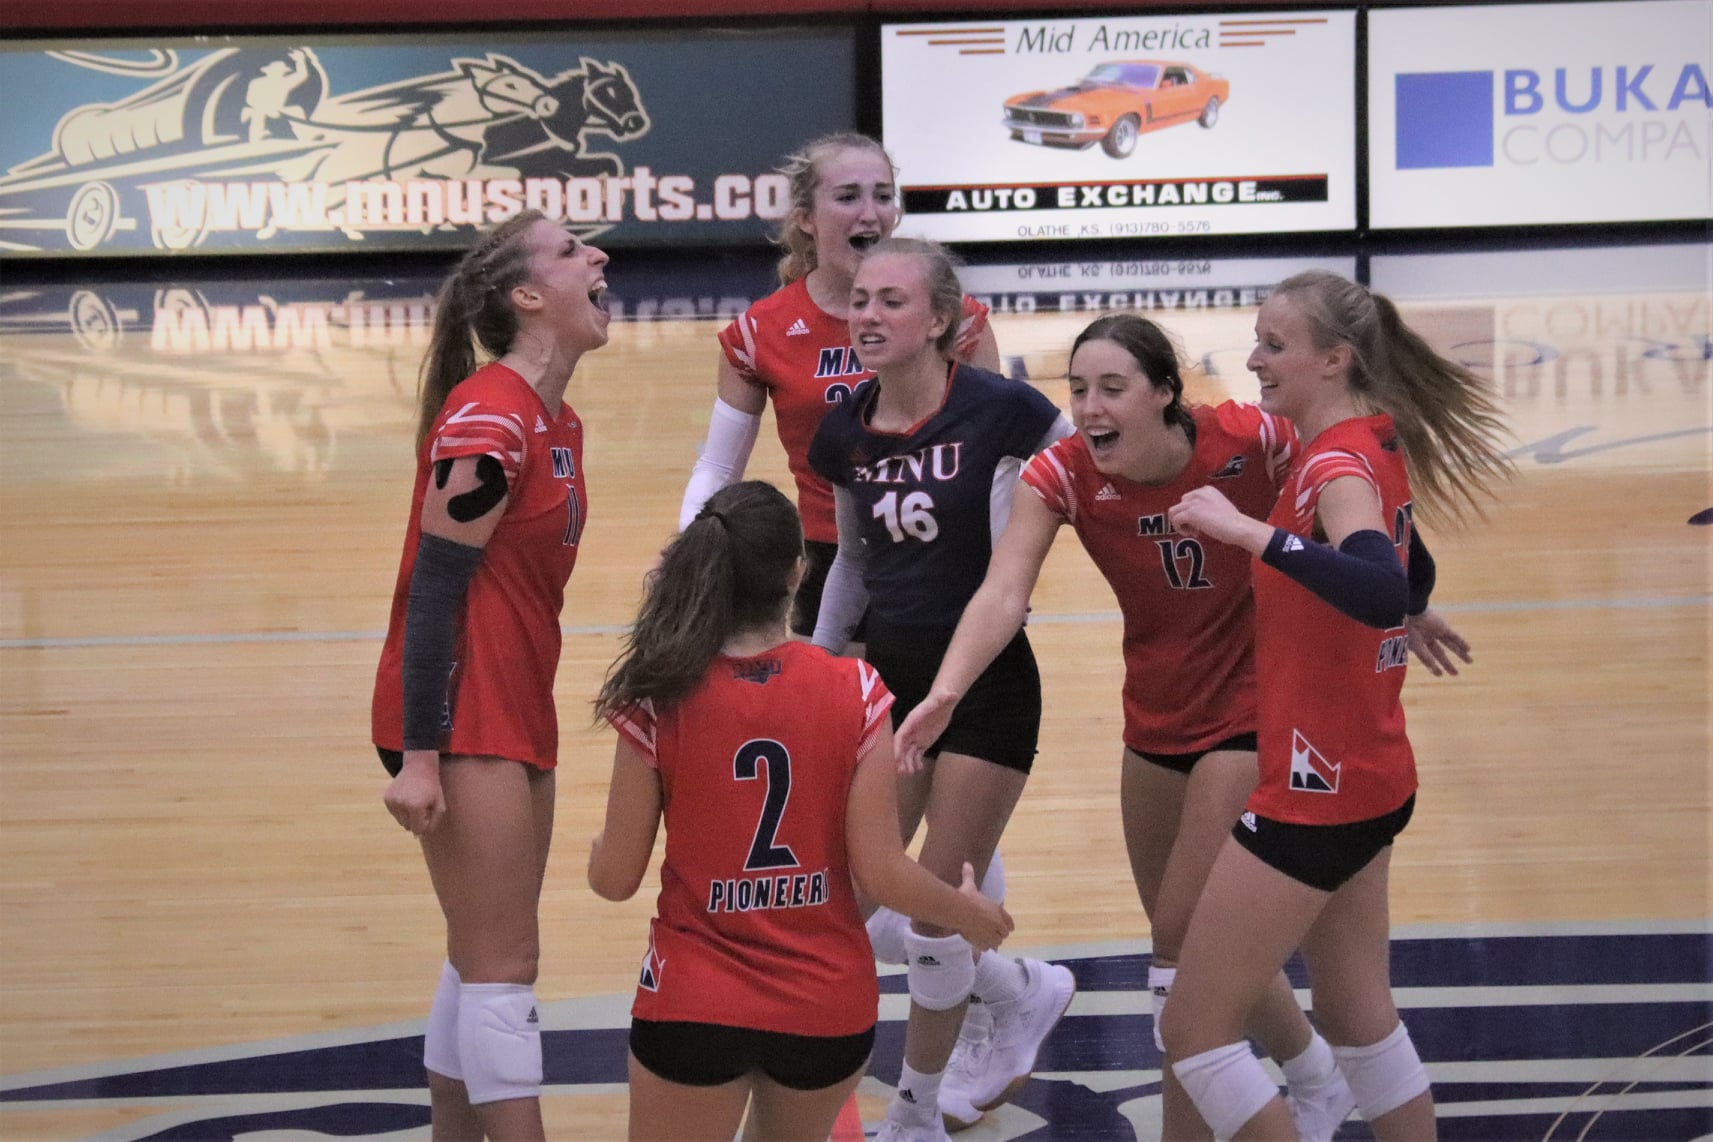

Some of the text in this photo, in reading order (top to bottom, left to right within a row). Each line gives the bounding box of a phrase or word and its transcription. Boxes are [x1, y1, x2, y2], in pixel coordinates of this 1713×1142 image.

[1015, 22, 1211, 54] Mid America
[1503, 62, 1713, 116] BUKA
[1501, 119, 1713, 167] COMPA
[145, 165, 792, 231] www.mnusports.co
[945, 188, 1037, 212] AUTO
[1056, 180, 1257, 209] EXCHANGE
[1017, 224, 1071, 239] OLATHE
[1109, 219, 1212, 236] (913)780-5576
[871, 490, 940, 544] 16
[1154, 537, 1215, 591] 12
[732, 737, 801, 872] 2
